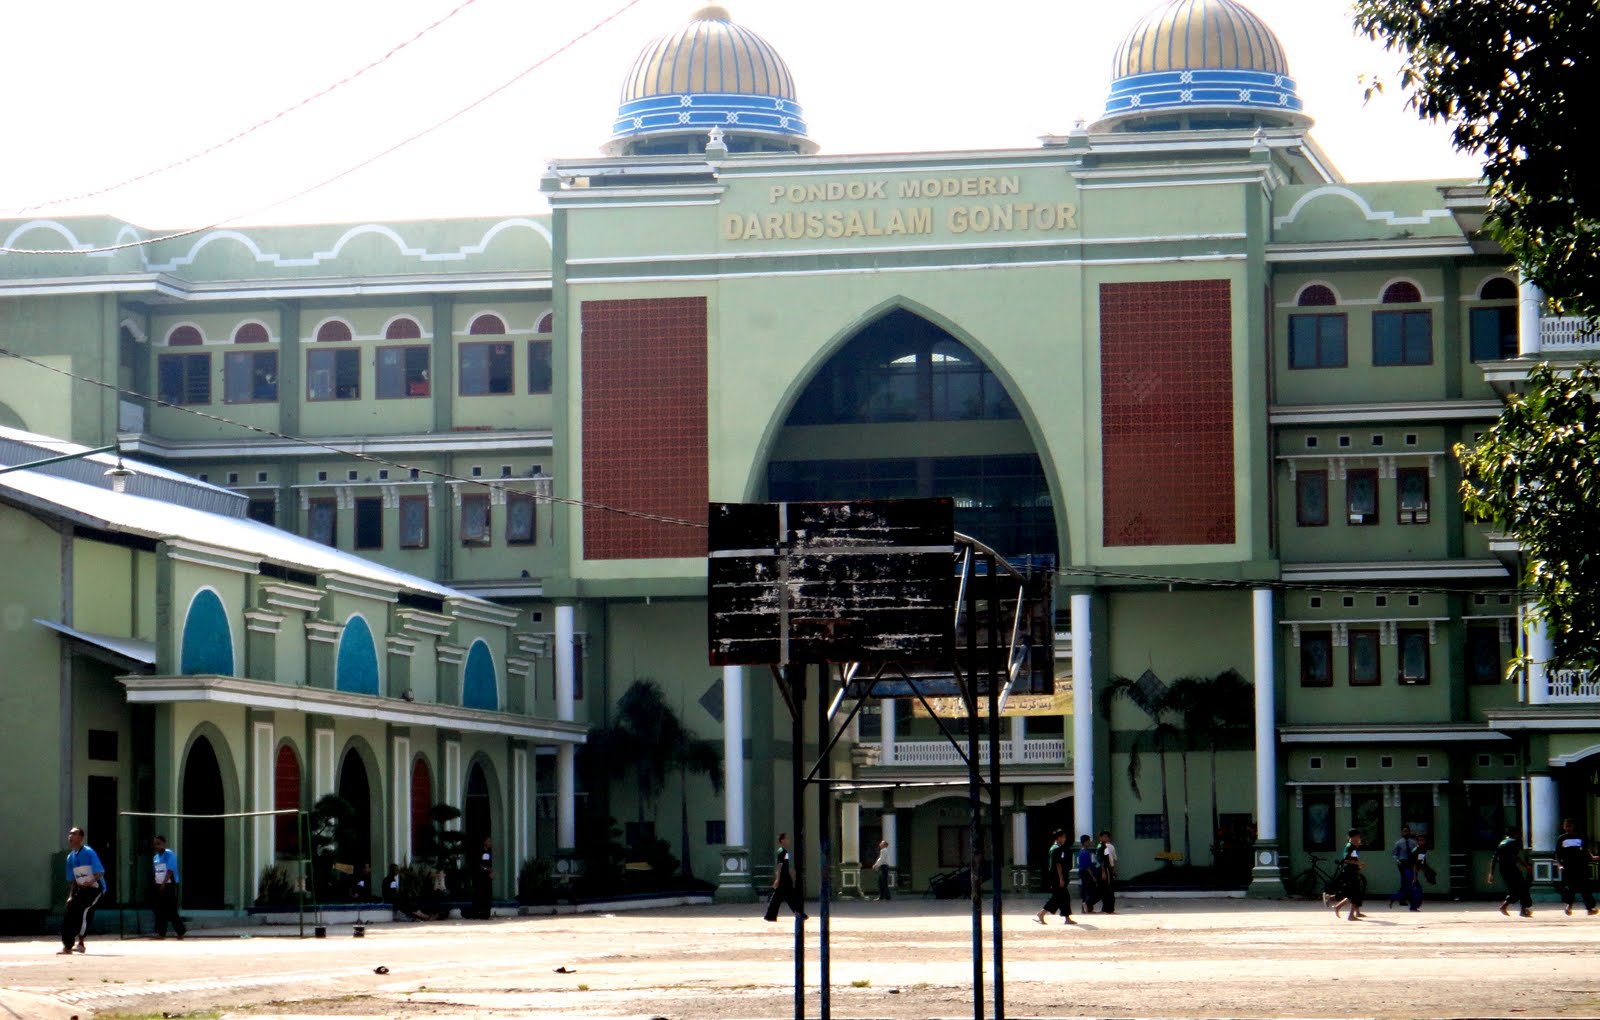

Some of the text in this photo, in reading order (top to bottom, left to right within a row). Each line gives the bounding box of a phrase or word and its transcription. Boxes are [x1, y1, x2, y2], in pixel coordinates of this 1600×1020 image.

[769, 175, 1020, 203] PONDOK MODERN
[724, 202, 1078, 241] DARUSSALAM GONTOR
